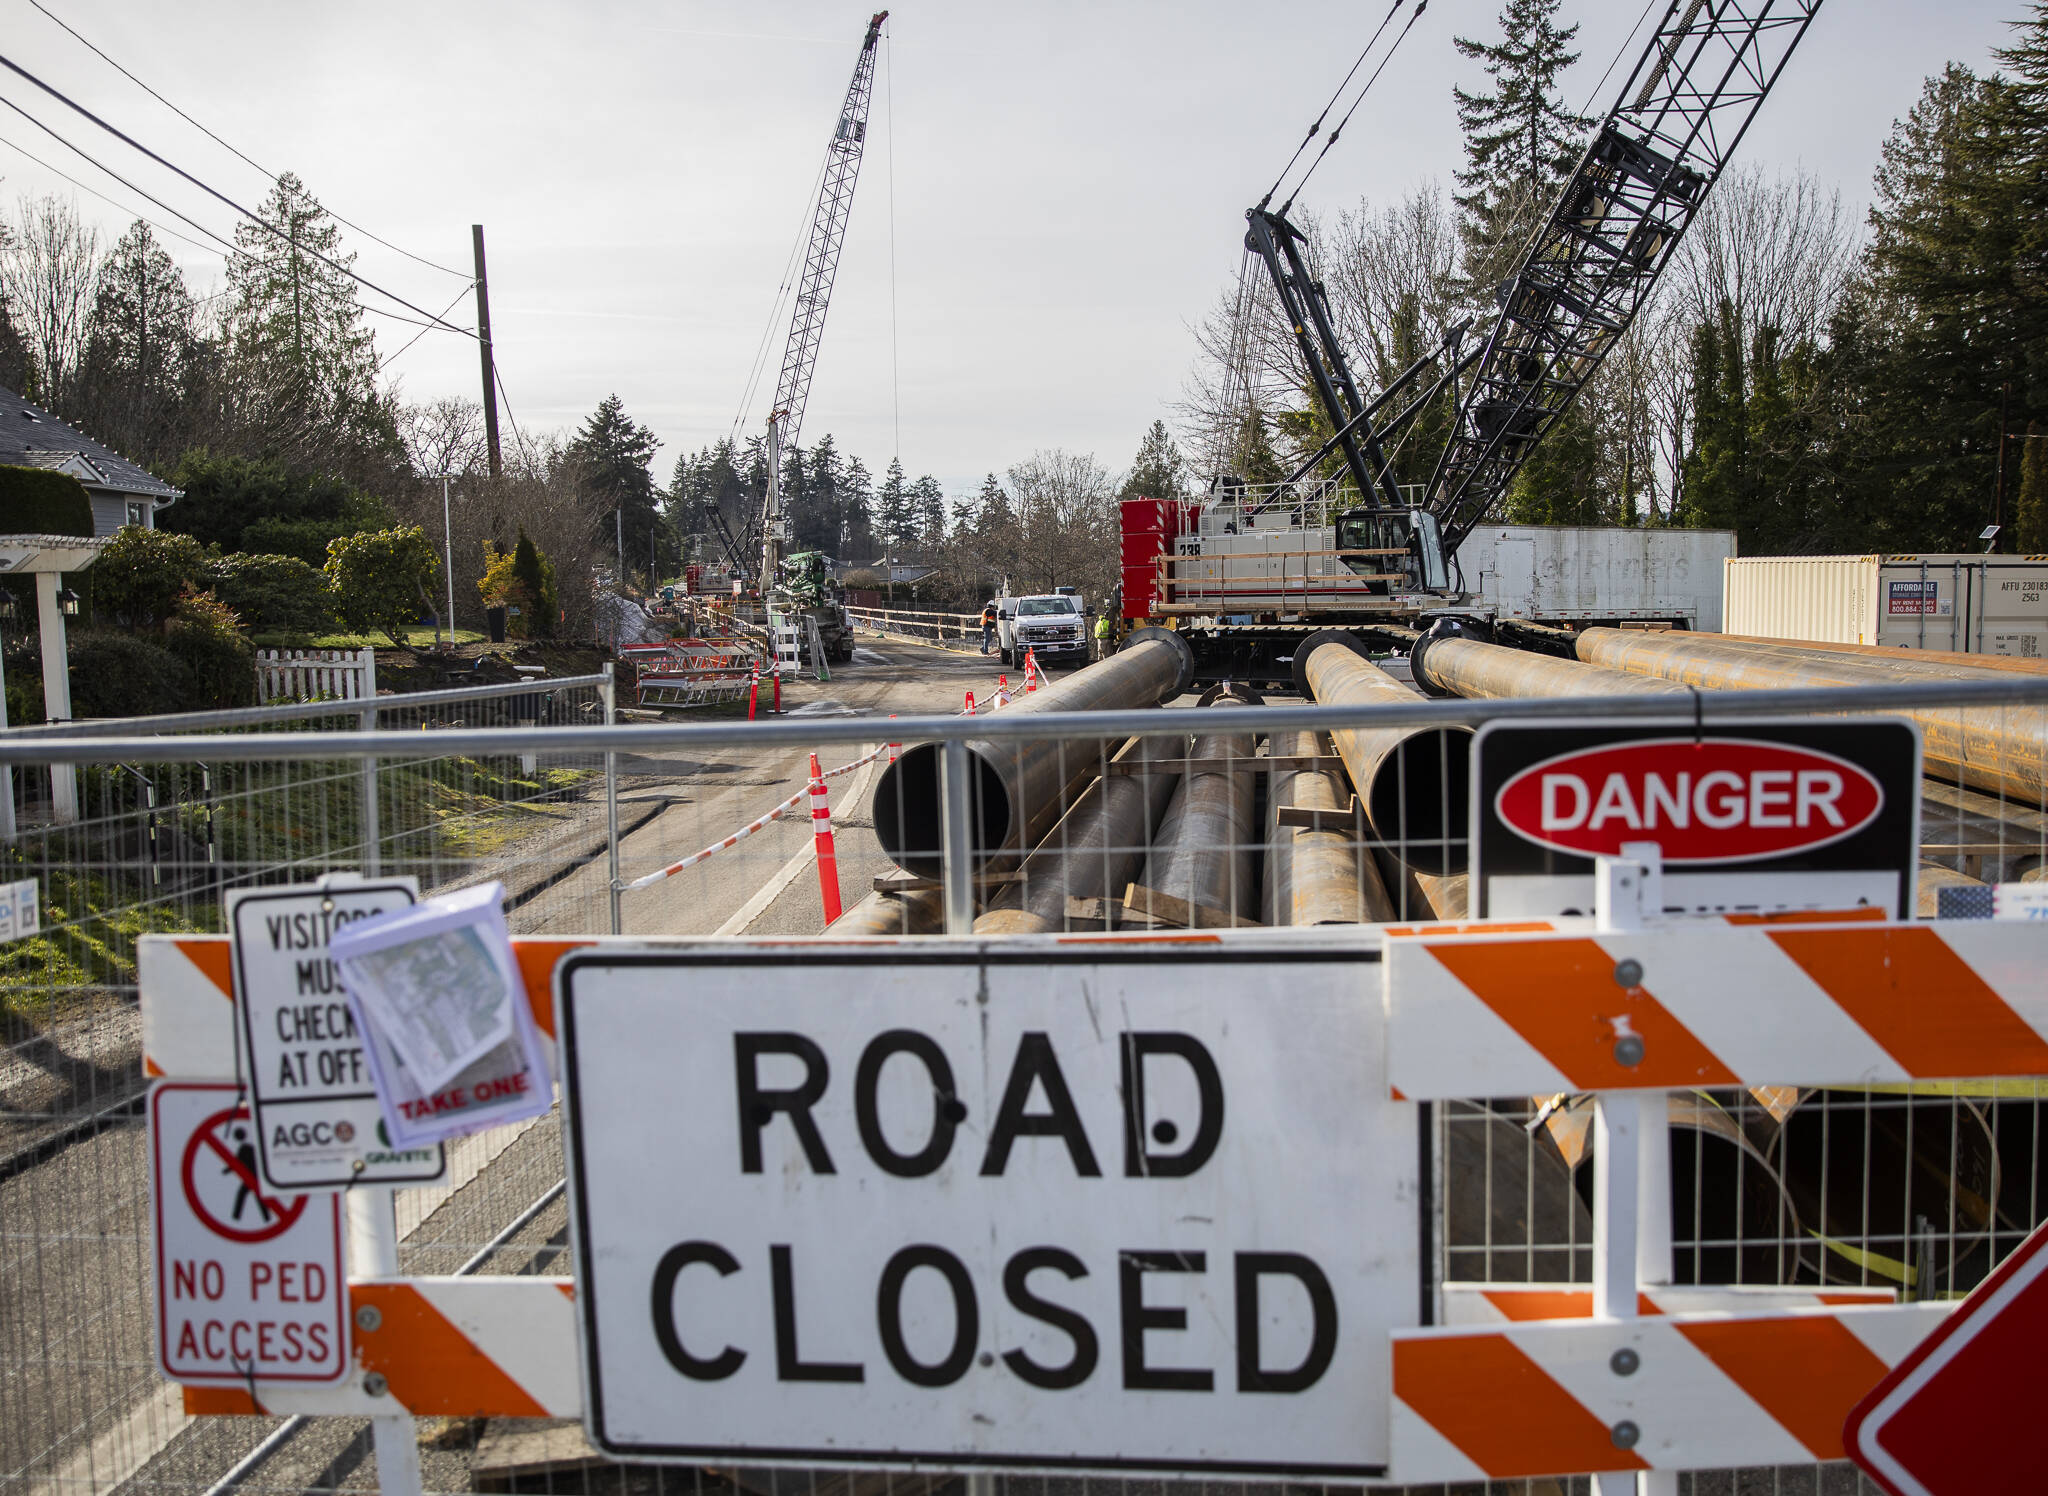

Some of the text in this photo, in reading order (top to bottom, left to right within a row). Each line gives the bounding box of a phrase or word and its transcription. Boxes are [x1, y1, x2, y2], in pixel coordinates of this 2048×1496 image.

[1892, 583, 1935, 592] AFFORDALE
[2001, 581, 2048, 591] AFFU 230183
[2022, 592, 2040, 602] 25G3
[1891, 605, 1935, 613] 800.884.382
[1540, 770, 1846, 831] DANGER
[296, 959, 347, 996] MUS
[279, 1051, 309, 1088] AT
[398, 1072, 531, 1121] TAKE ONE
[733, 1028, 1225, 1179] ROAD
[273, 1121, 331, 1148] AGC
[173, 1260, 327, 1303] NO PED
[650, 1240, 1339, 1394] CLOSED
[176, 1319, 329, 1363] ACCESS
